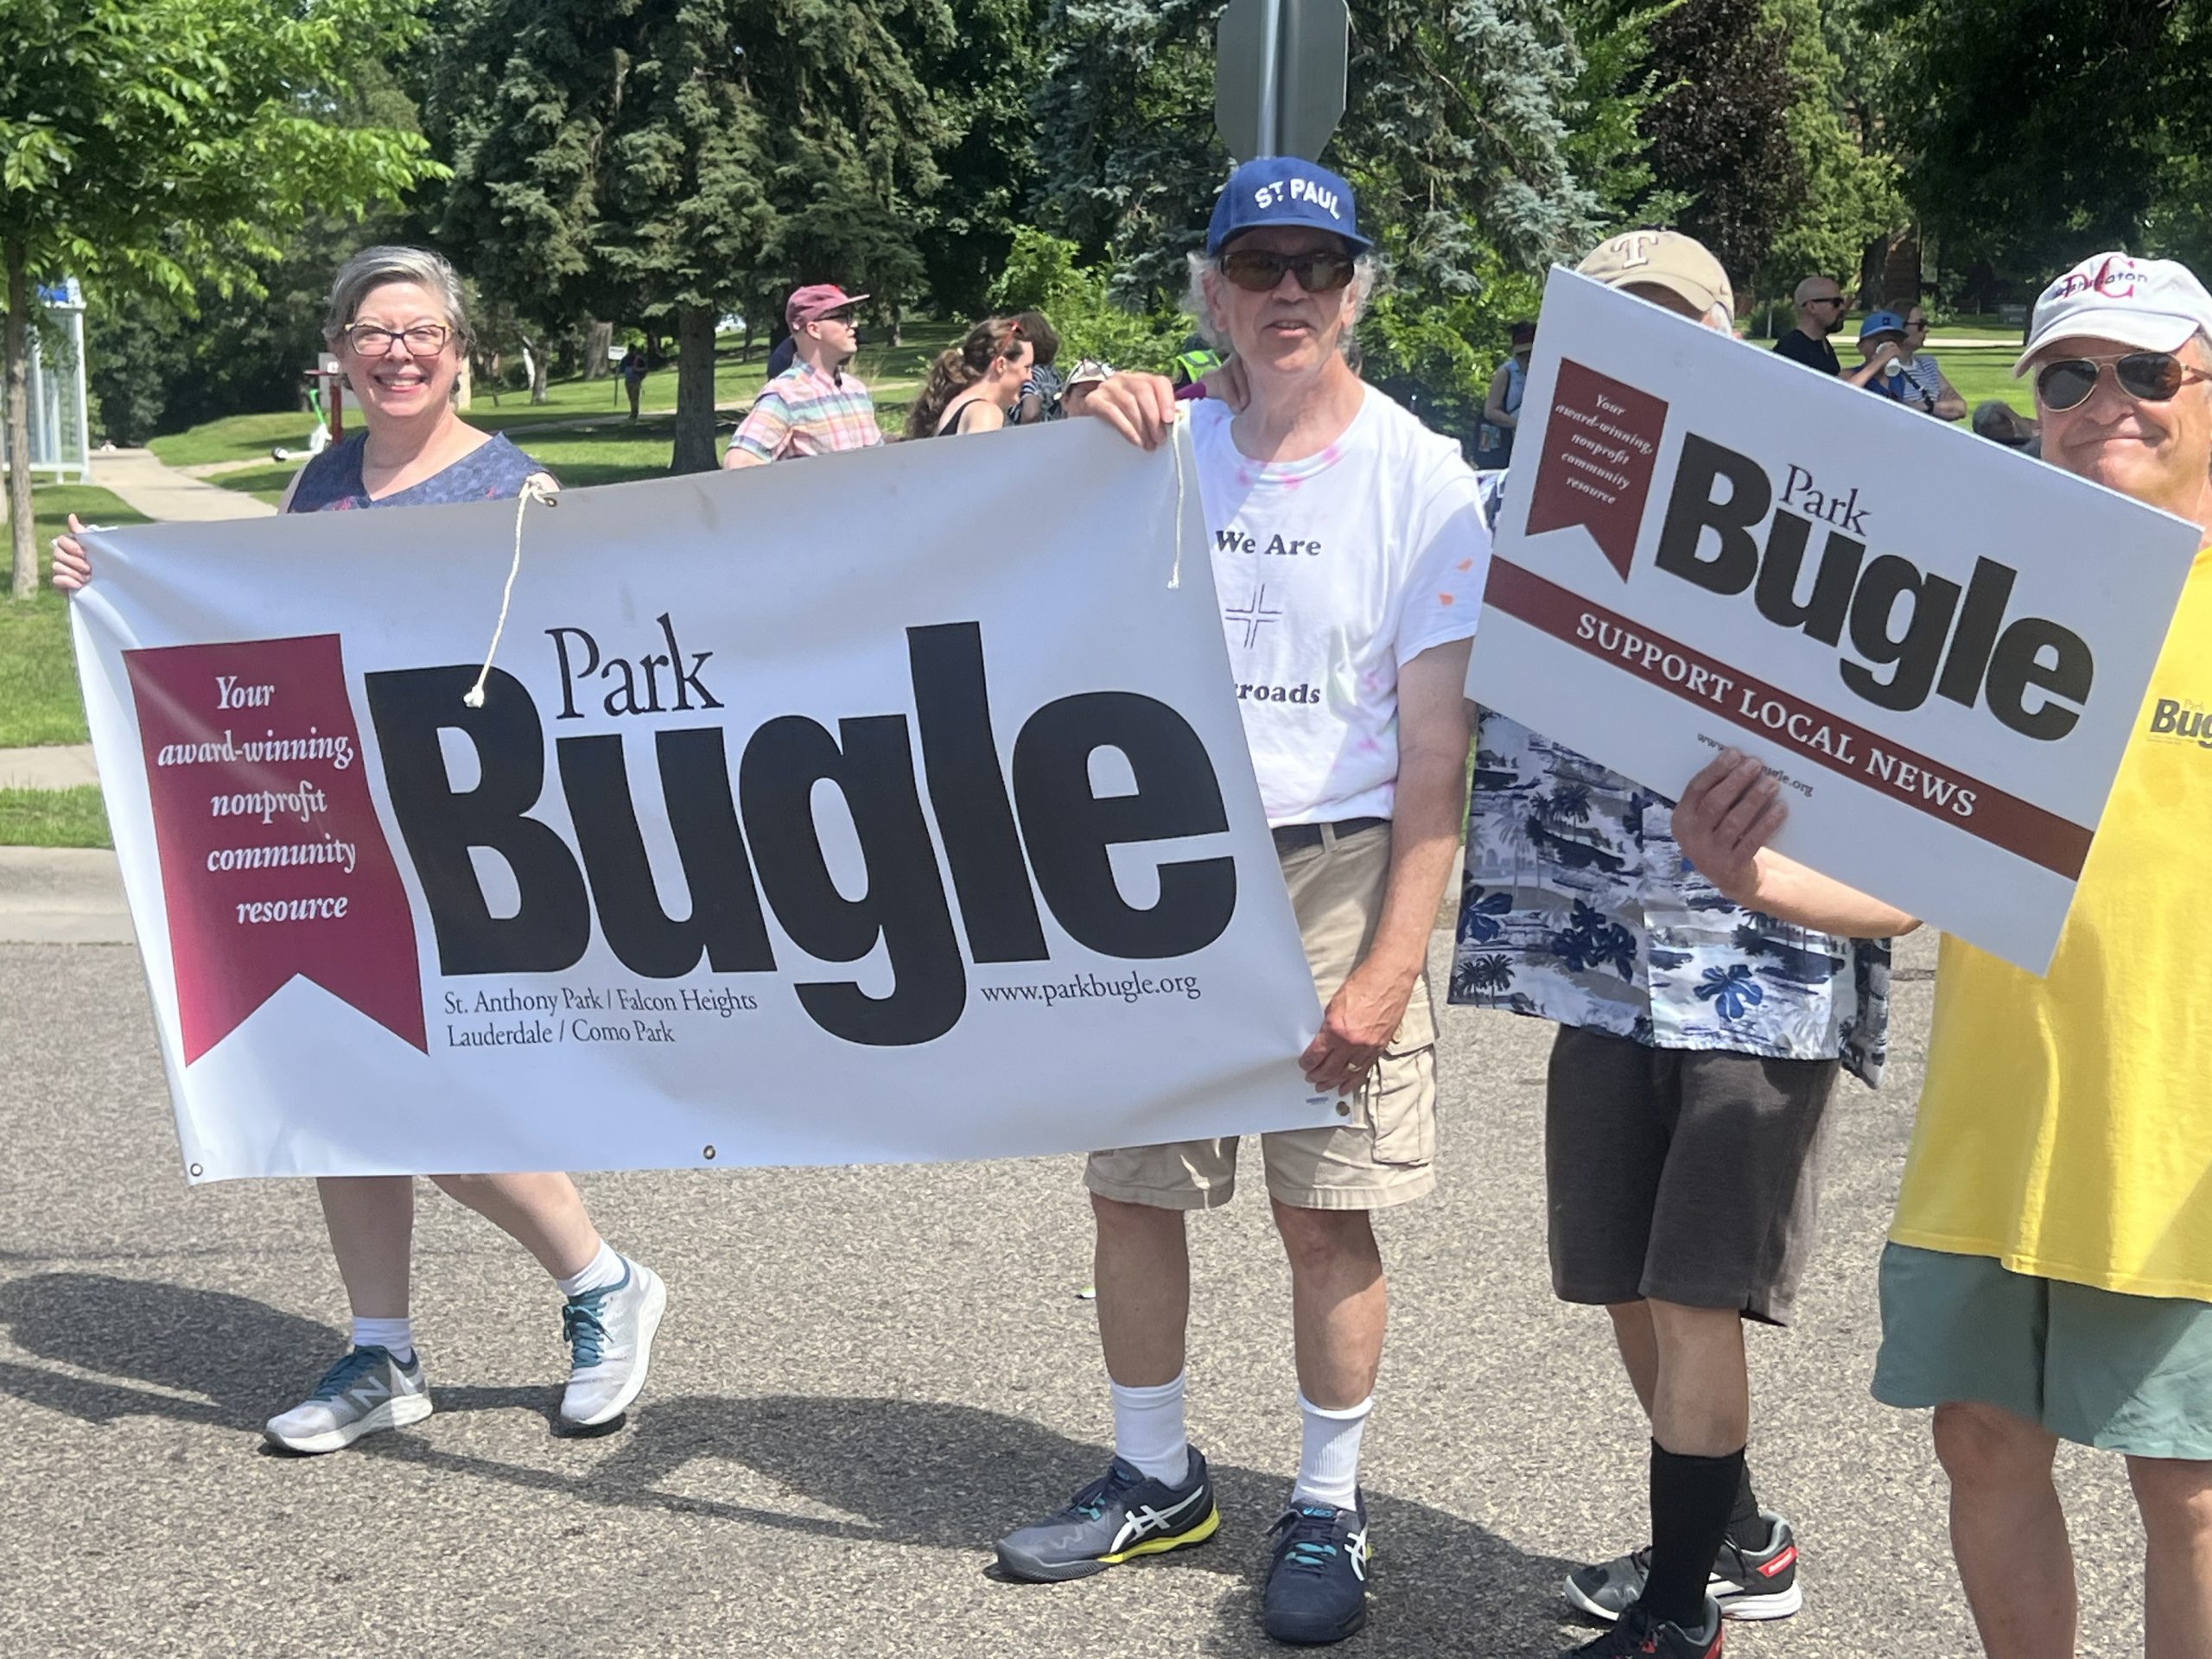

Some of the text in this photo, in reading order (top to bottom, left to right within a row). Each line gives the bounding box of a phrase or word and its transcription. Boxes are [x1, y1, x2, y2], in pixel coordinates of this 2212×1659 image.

[1289, 178, 1340, 220] PAUL
[1611, 233, 1659, 270] T
[1596, 394, 1626, 416] Your
[1571, 434, 1630, 465] nonprofit
[1561, 452, 1630, 491] community
[1566, 476, 1616, 505] resource
[1778, 464, 1872, 537] Park
[1215, 530, 1322, 556] We Are
[1655, 432, 2094, 742] Bugle
[545, 613, 724, 719] Park
[215, 675, 275, 709] Your
[1235, 683, 1320, 705] roads
[1576, 612, 1978, 818] SUPPORT LOCAL NEWS
[210, 780, 327, 824] nonprofit
[364, 621, 1237, 1046] Bugle
[207, 833, 356, 874] community
[236, 896, 348, 924] resource
[444, 991, 468, 1014] St.
[474, 988, 558, 1016] Anthony
[562, 987, 602, 1010] Park
[617, 988, 678, 1012] Falcon
[679, 987, 758, 1018] Heights
[981, 971, 1201, 1007] www.parkbugle.org
[447, 1020, 553, 1047] Lauderdale
[572, 1019, 631, 1042] Como
[633, 1020, 677, 1043] Park
